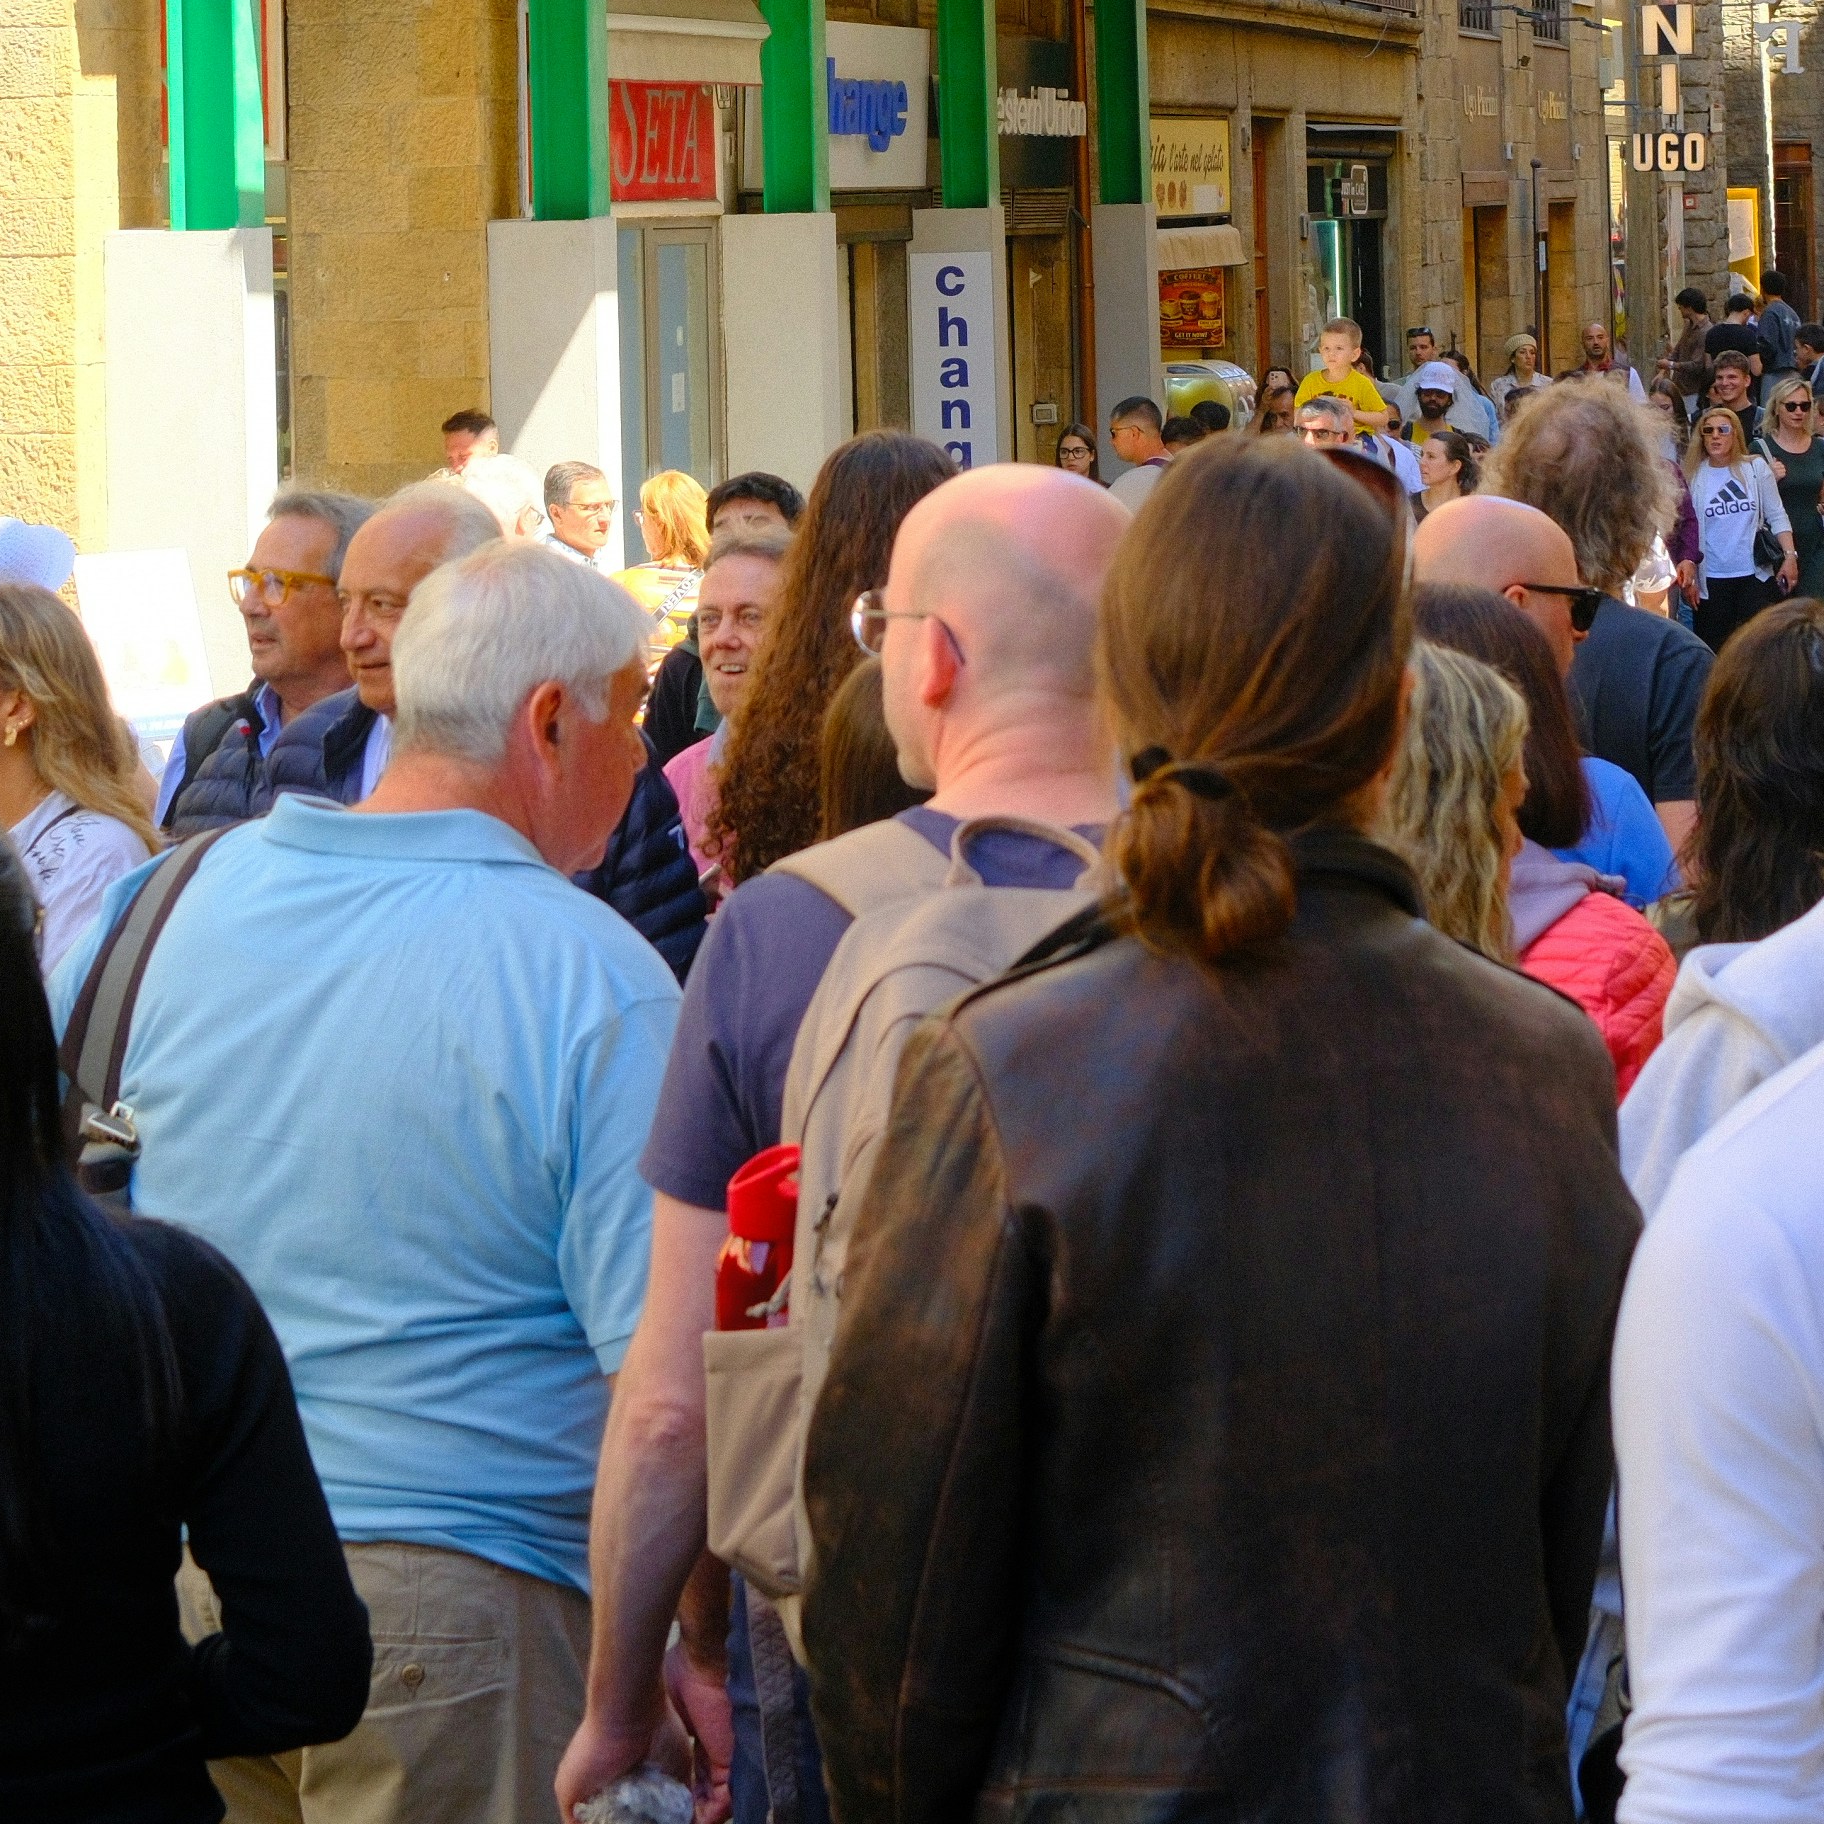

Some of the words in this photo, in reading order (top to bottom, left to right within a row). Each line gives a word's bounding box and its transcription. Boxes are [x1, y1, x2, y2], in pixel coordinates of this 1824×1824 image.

[826, 56, 908, 153] hange
[997, 86, 1037, 135] estern
[1633, 132, 1706, 172] UGO
[936, 266, 972, 472] chang
[1705, 500, 1757, 517] adidas
